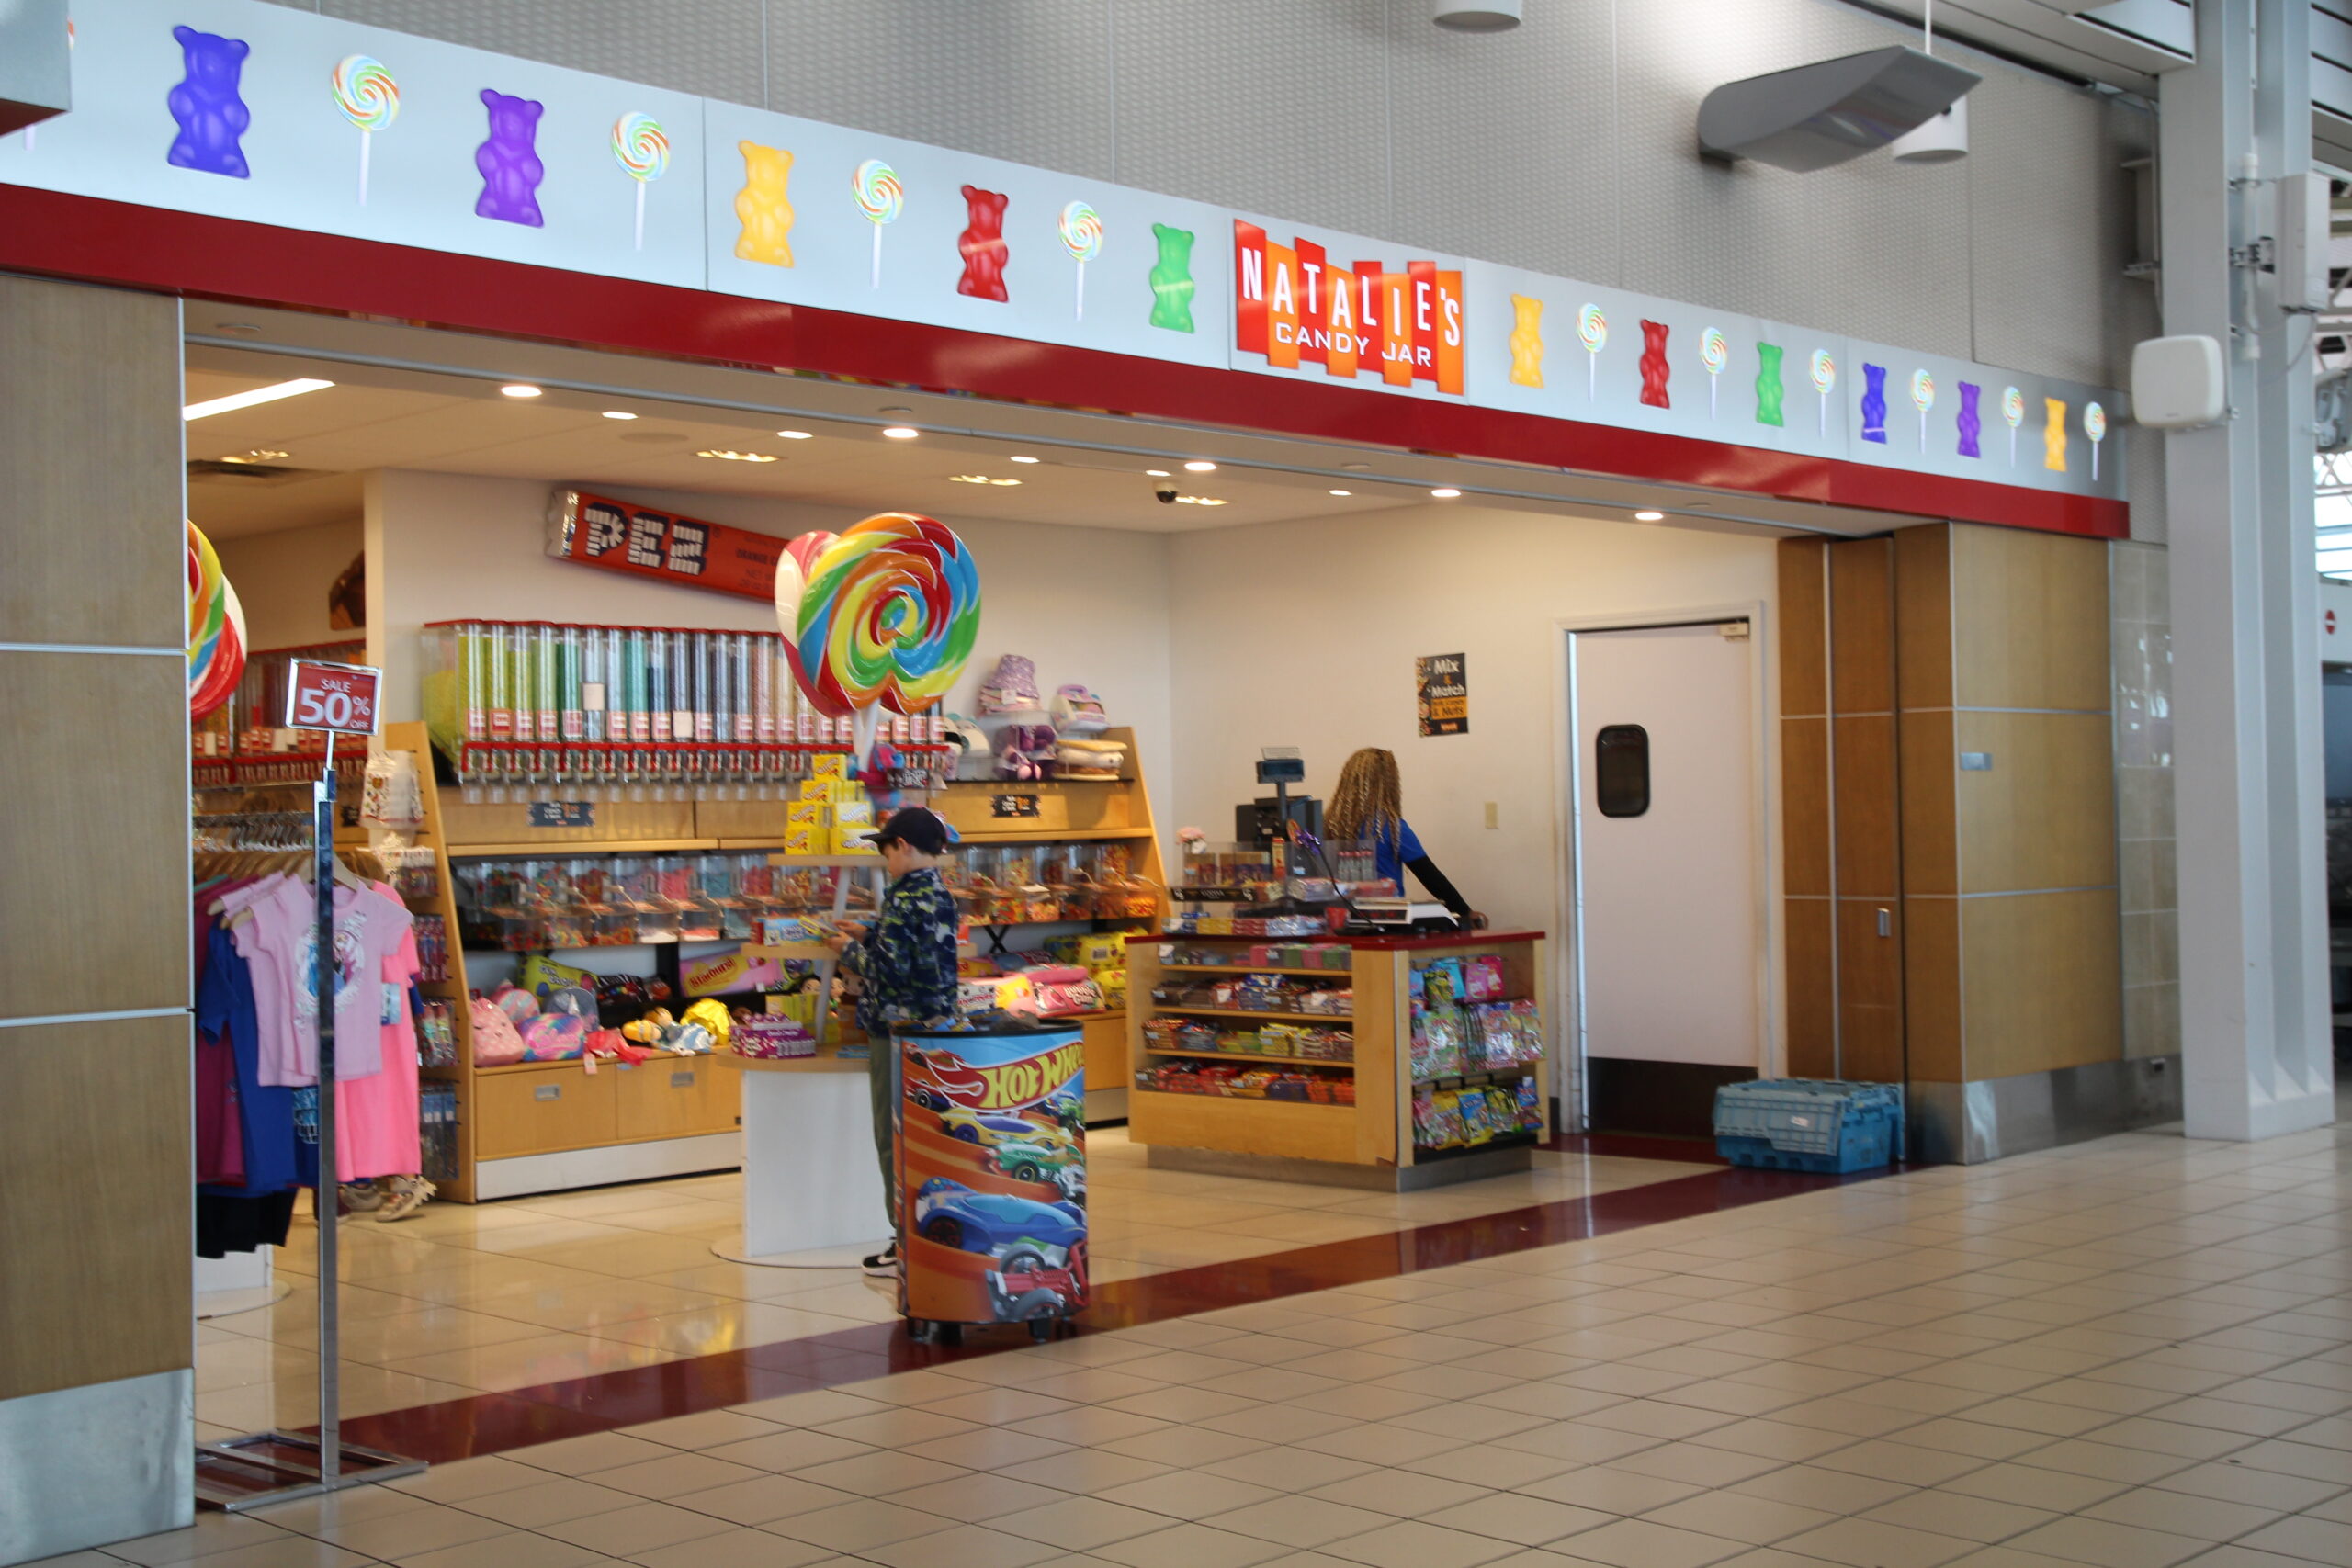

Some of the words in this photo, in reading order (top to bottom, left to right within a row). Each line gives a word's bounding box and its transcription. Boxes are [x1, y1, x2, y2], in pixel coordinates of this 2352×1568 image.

[1275, 321, 1370, 356] CANDY
[1381, 341, 1432, 367] JAR
[583, 502, 708, 575] PEZ
[321, 678, 352, 694] SALE
[349, 719, 369, 730] OFF
[977, 1062, 1042, 1109] HOT
